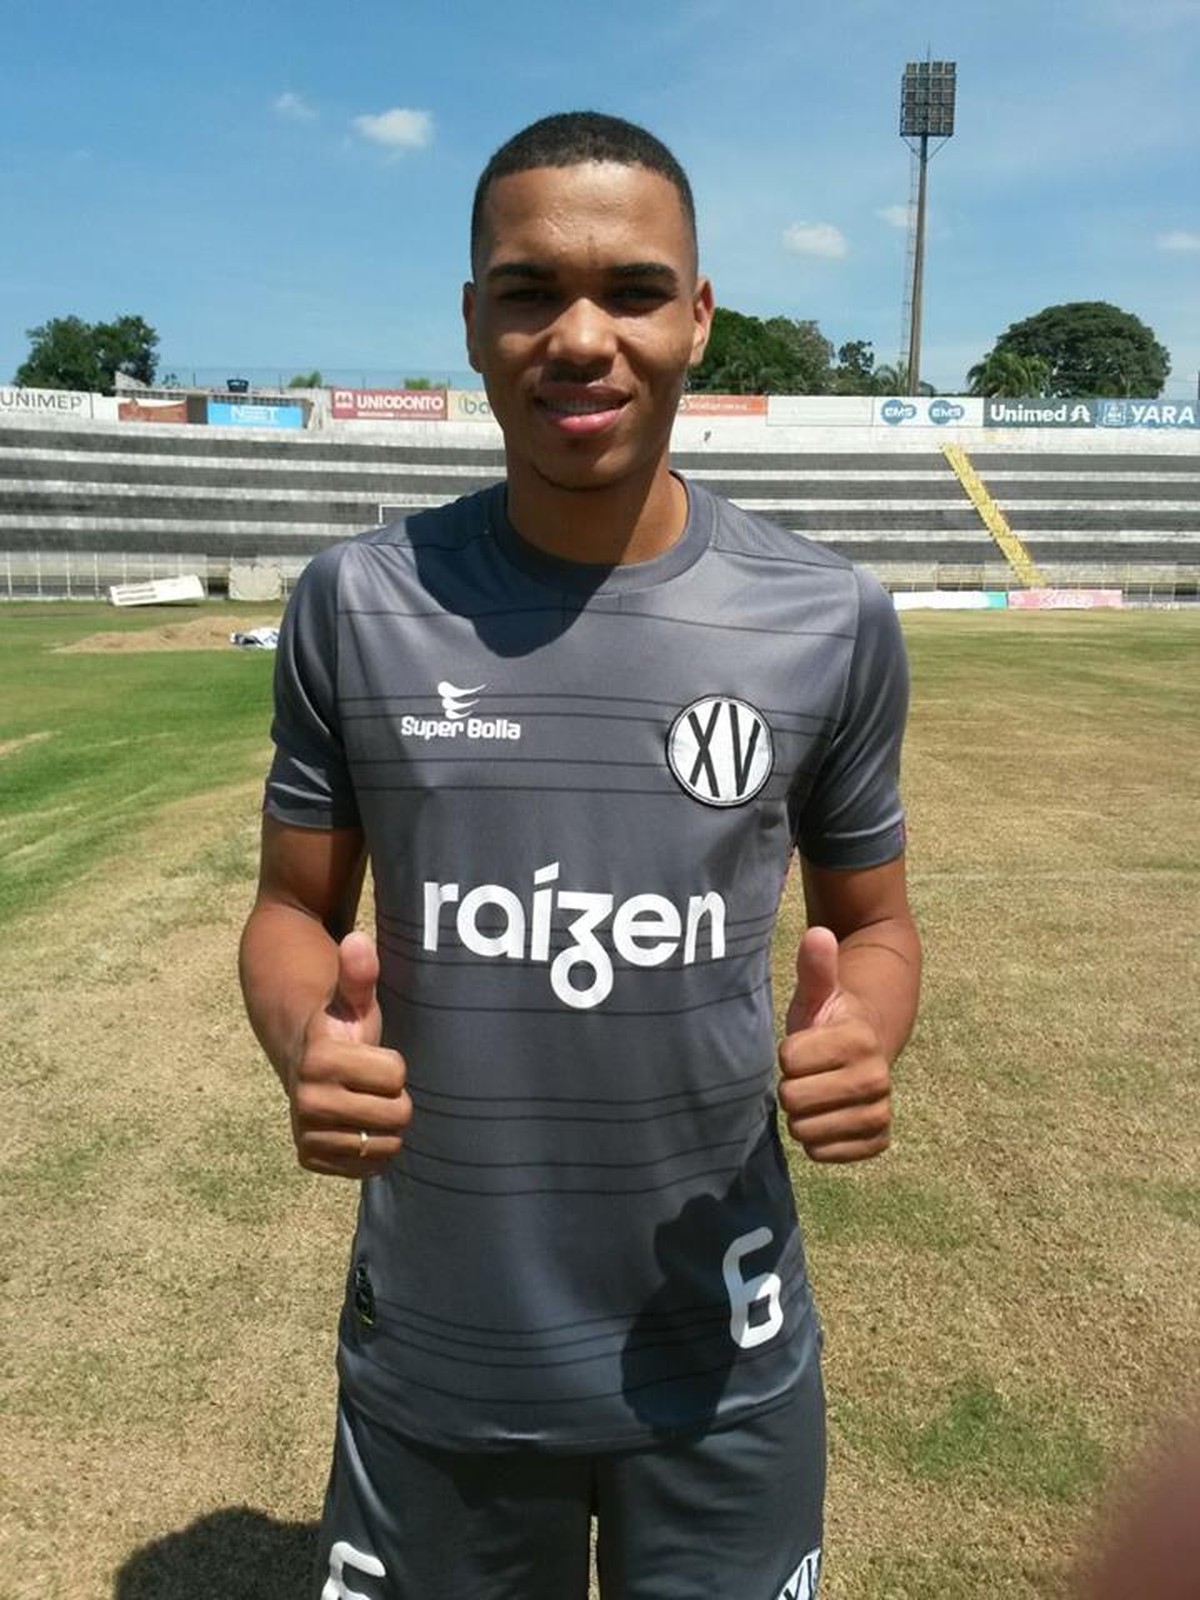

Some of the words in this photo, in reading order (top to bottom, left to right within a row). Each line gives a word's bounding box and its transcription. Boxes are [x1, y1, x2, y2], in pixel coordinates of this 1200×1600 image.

[0, 390, 82, 410] UNIMEP
[356, 395, 444, 410] UNIODONTO
[989, 404, 1066, 423] Unimed
[1130, 405, 1195, 425] YARA
[401, 716, 464, 740] Super
[467, 718, 521, 739] Bolla
[687, 701, 762, 798] XV
[722, 1226, 784, 1349] 6
